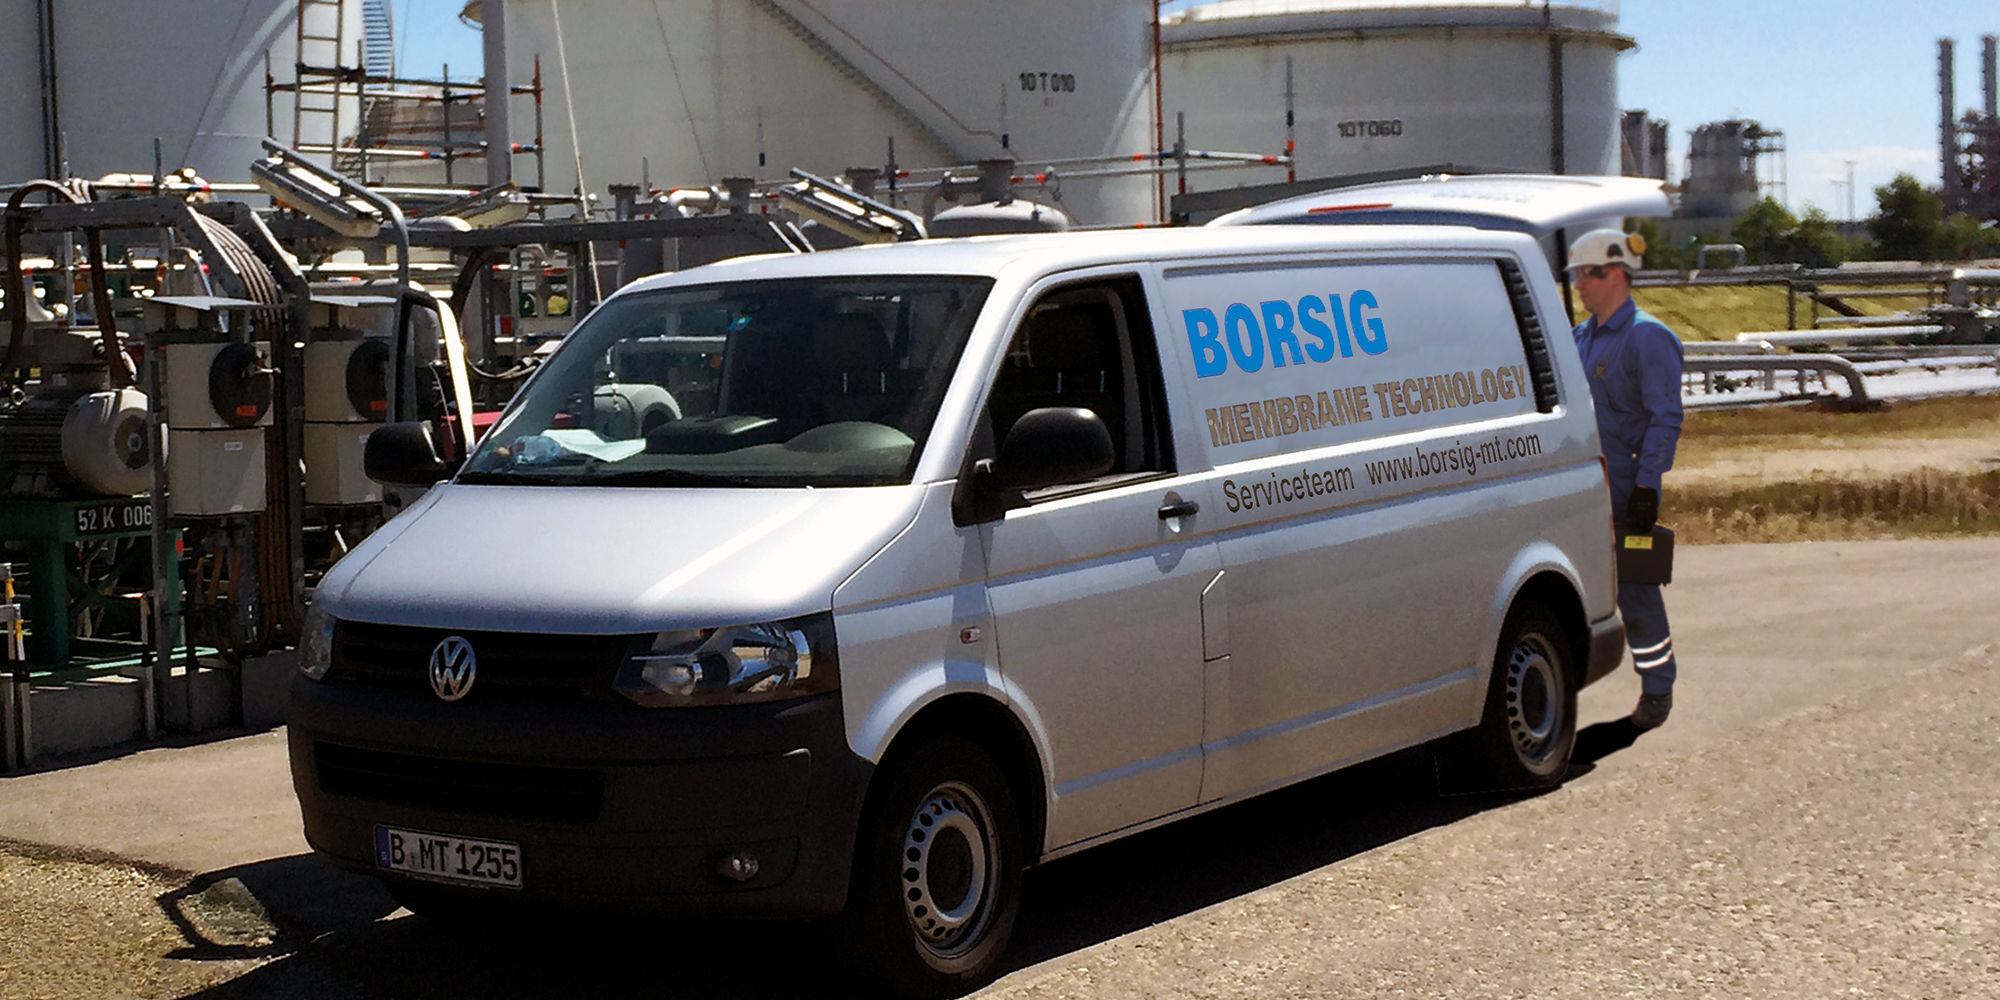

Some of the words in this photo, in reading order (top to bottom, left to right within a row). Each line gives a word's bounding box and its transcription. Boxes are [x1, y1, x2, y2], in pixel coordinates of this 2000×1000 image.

[1182, 289, 1388, 378] BORSIG
[1205, 386, 1373, 447] MEMBRANE
[1373, 364, 1526, 418] TECHNOLOGY
[1223, 467, 1355, 512] Serviceteam
[1365, 433, 1542, 485] www.borsig-mt.com
[78, 509, 97, 531] 52
[103, 506, 115, 528] K
[123, 505, 152, 526] 006
[390, 833, 405, 864] B
[419, 838, 449, 871] MT
[456, 843, 517, 881] 1255
